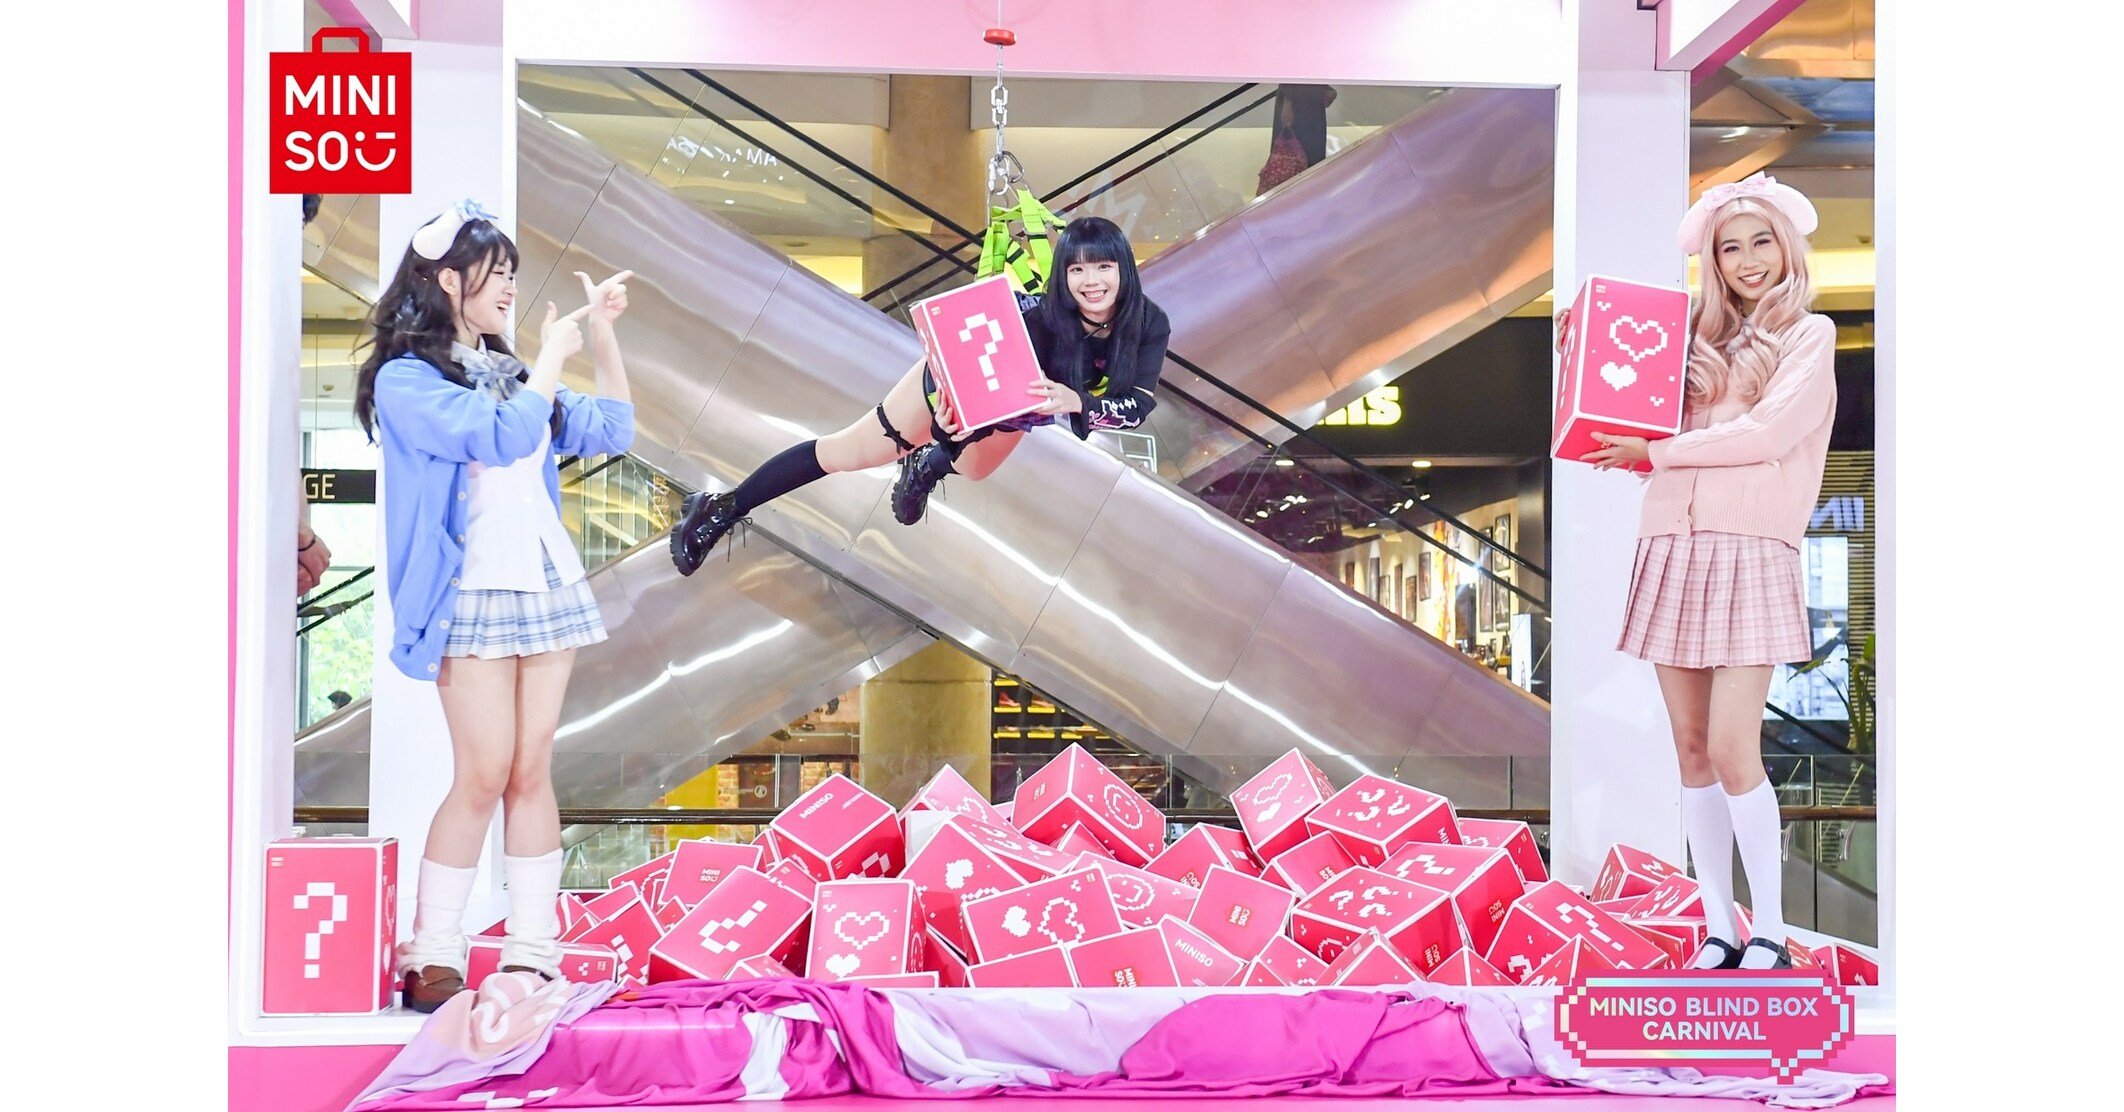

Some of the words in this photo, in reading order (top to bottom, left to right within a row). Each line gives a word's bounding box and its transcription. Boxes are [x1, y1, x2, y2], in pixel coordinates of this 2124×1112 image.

[799, 793, 834, 818] MINISO
[702, 868, 721, 876] MINI
[1229, 904, 1242, 924] MINI
[1491, 908, 1506, 922] MINI
[1175, 938, 1214, 968] MINISO
[1424, 948, 1435, 967] MINI
